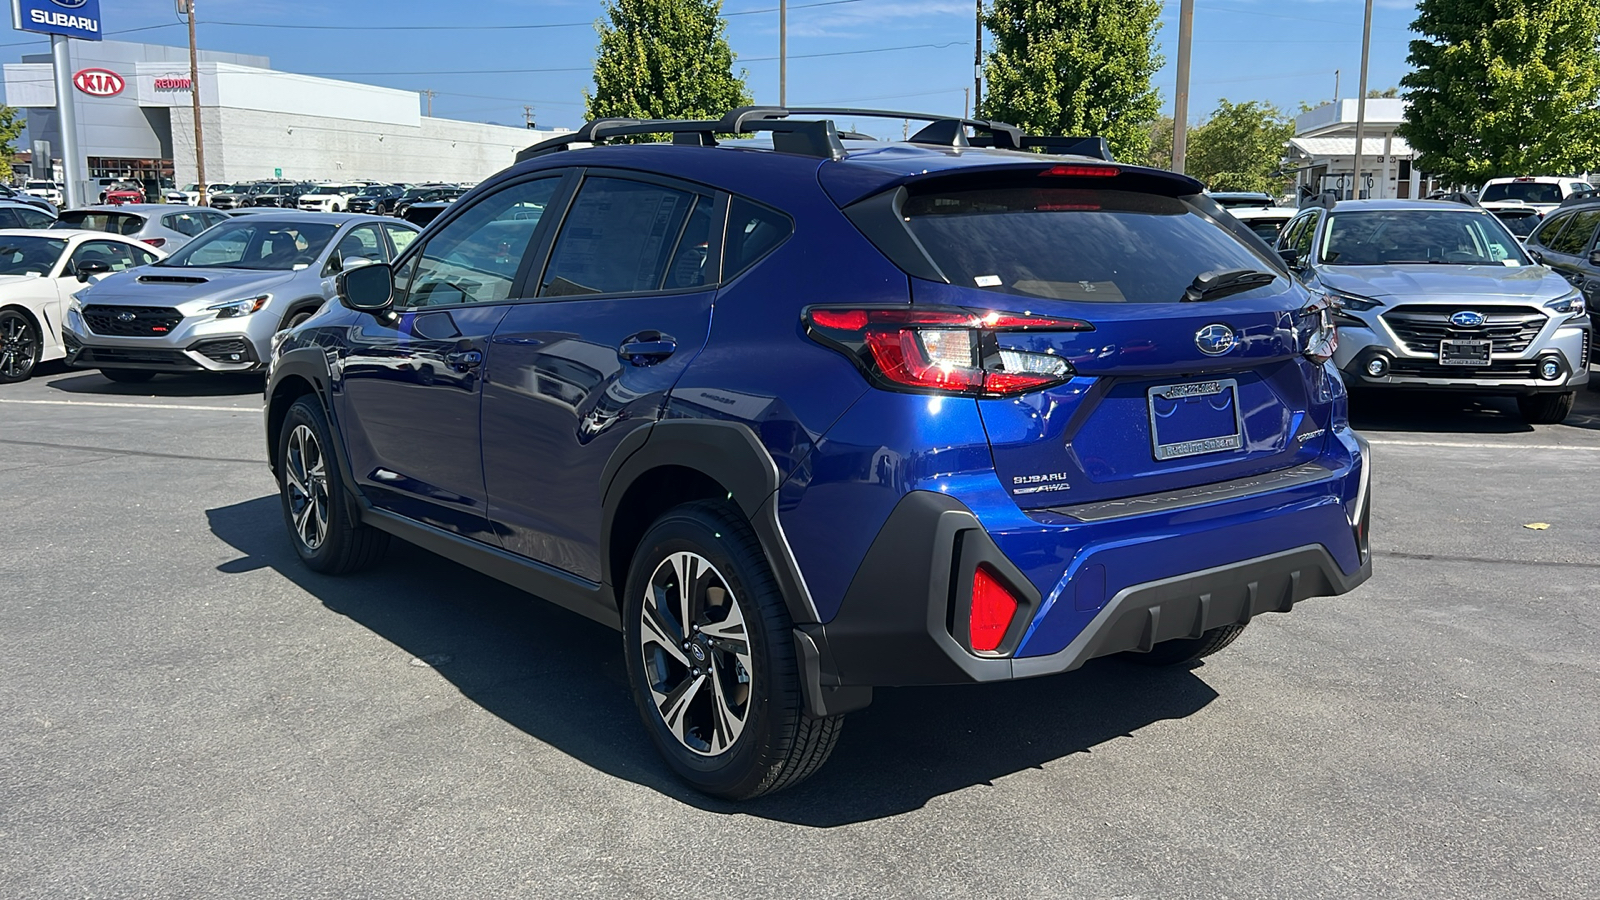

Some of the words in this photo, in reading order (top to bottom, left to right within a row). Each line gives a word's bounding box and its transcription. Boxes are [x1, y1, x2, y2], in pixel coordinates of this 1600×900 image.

[30, 9, 98, 32] SUBARU
[81, 73, 117, 92] KIA
[155, 78, 192, 89] REDDIN
[1013, 472, 1067, 484] SUBARU
